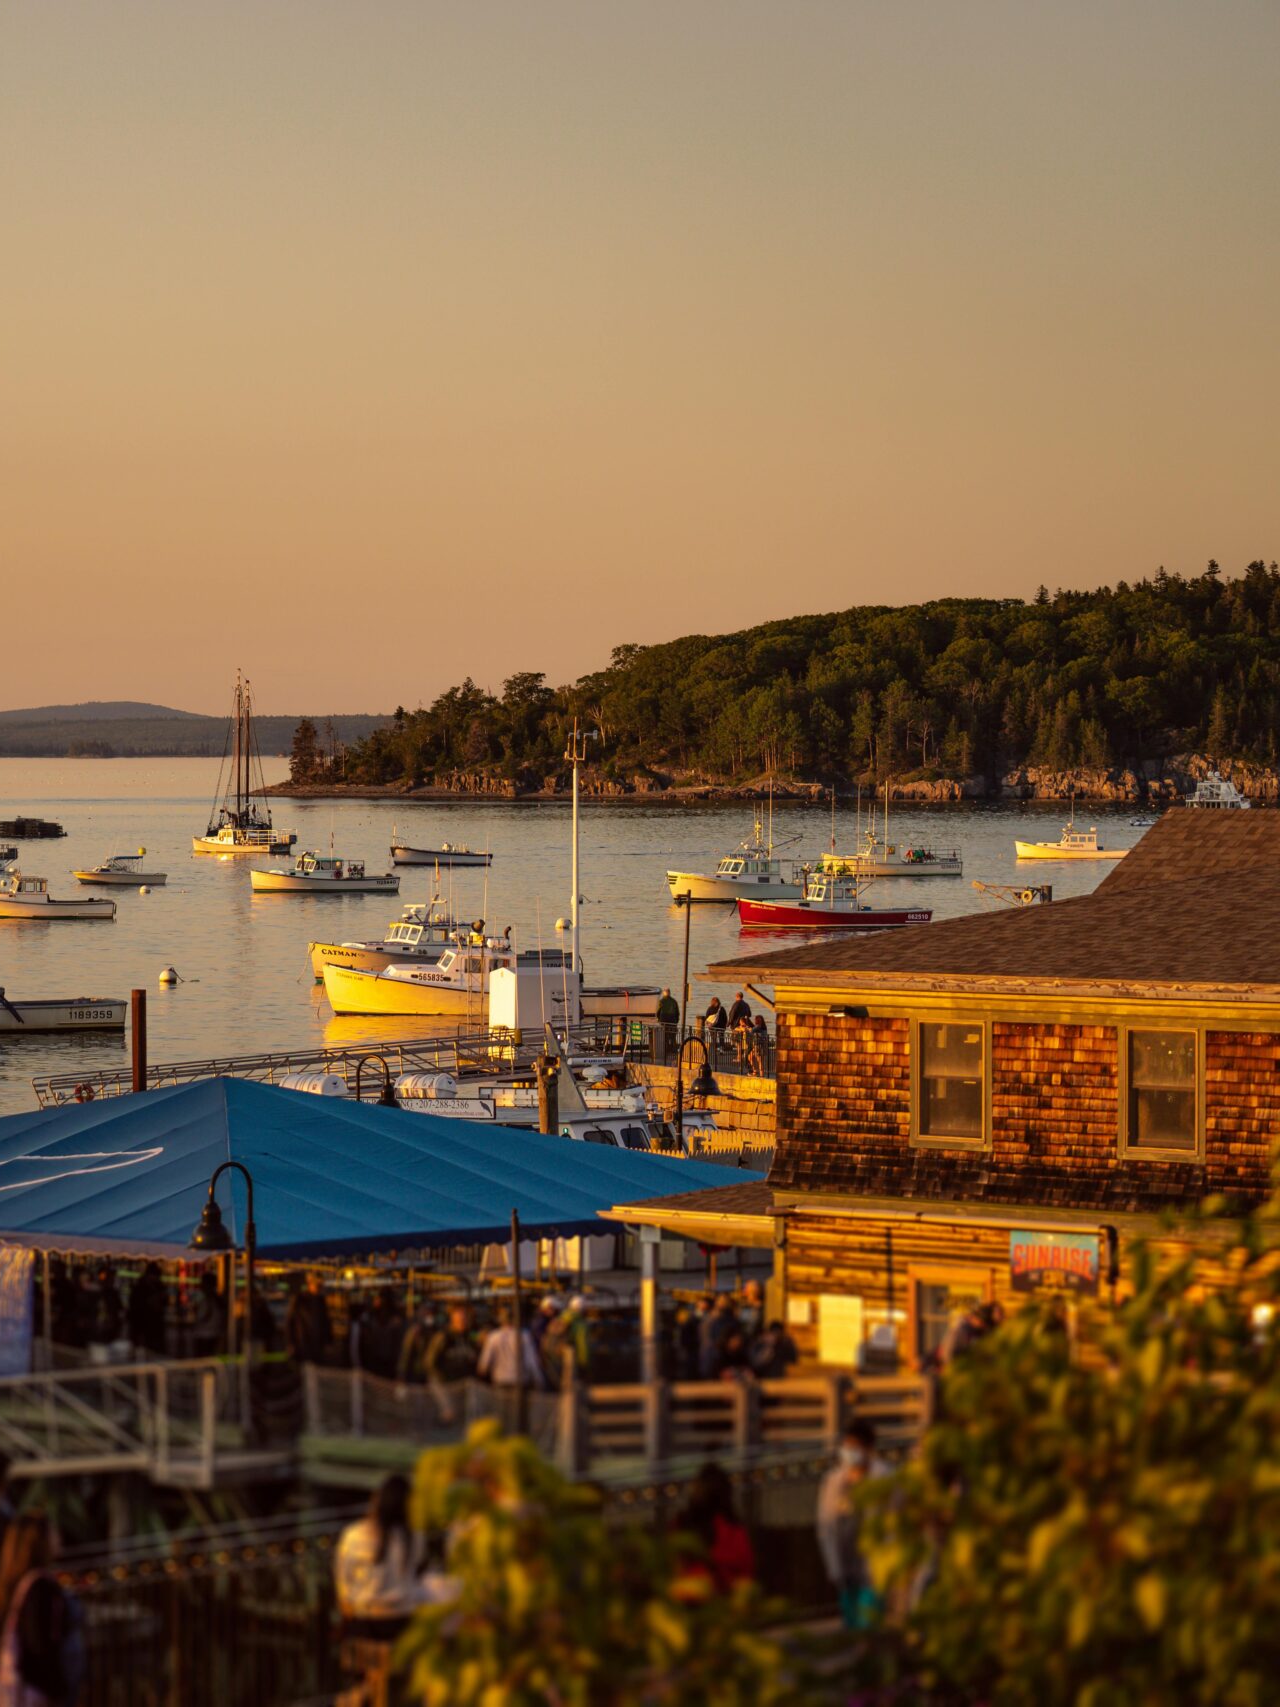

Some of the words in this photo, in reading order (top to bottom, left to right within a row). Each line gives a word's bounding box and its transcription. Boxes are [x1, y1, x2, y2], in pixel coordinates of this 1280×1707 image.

[321, 948, 357, 957] CATMAN
[418, 972, 444, 982] 565835
[419, 1099, 469, 1109] 207-288-2386
[1012, 1243, 1095, 1281] SUNRISE
